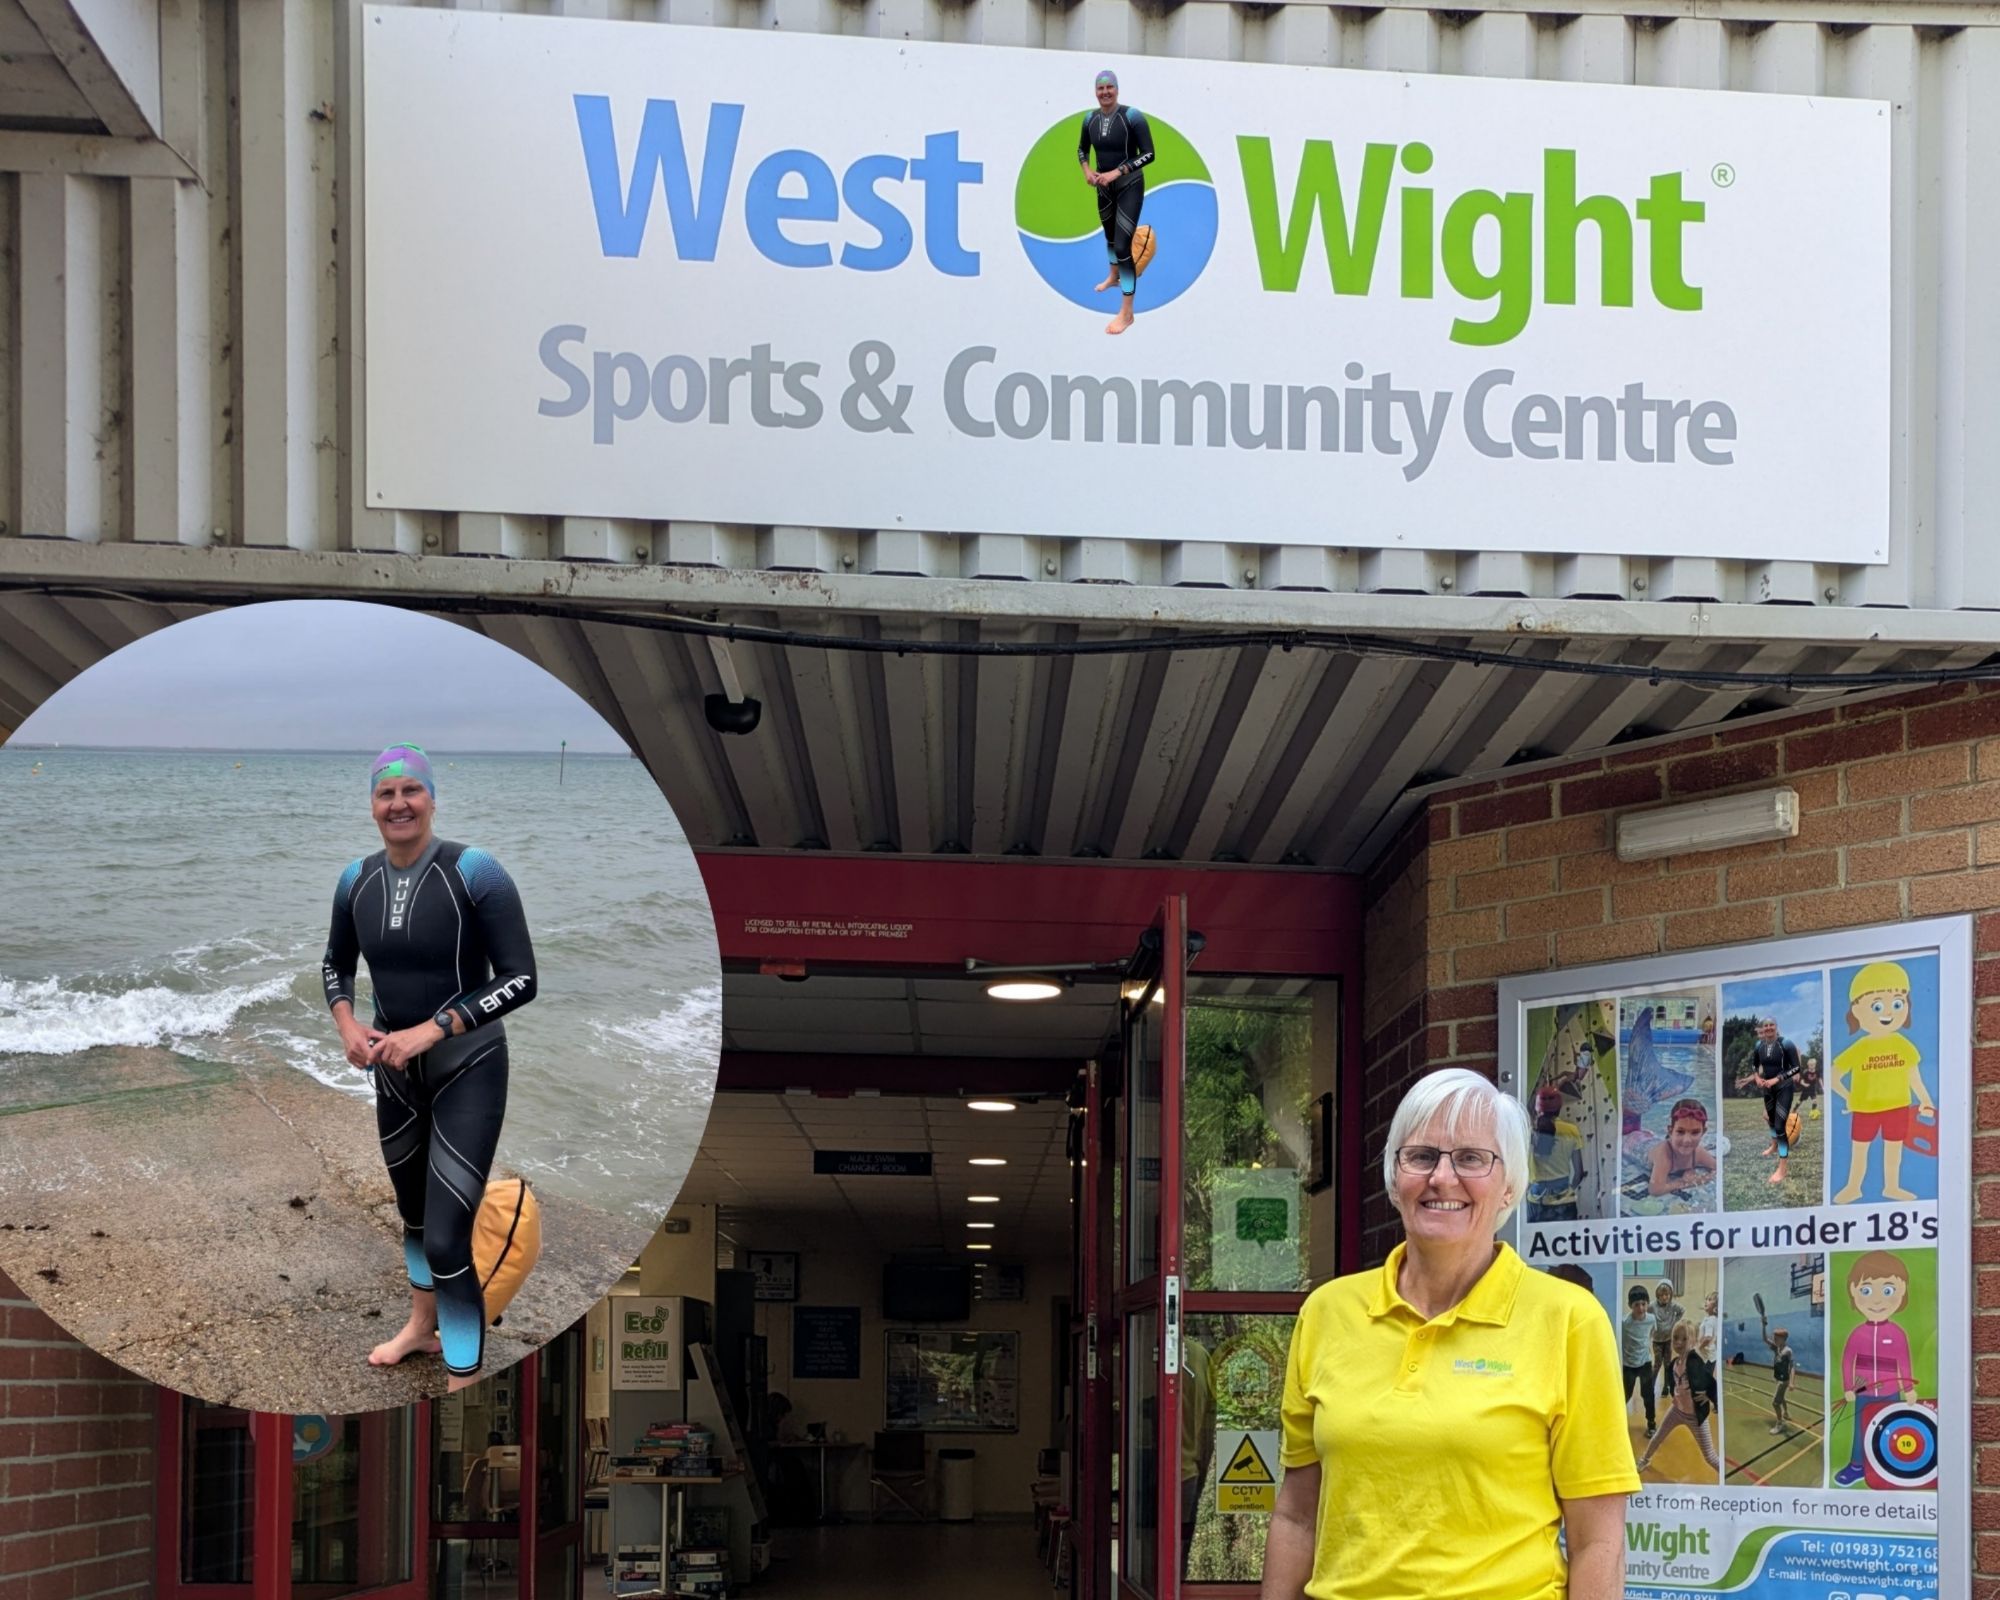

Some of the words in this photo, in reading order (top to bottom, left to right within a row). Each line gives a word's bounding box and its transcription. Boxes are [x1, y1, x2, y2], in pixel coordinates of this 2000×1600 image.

[573, 94, 983, 276] West
[1236, 135, 1705, 346] Wight
[538, 324, 823, 445] Sports
[841, 340, 913, 433] &
[944, 346, 1452, 482] Community
[1464, 369, 1737, 465] Centre
[391, 877, 410, 928] HUUB
[744, 919, 774, 927] LICENSED
[786, 920, 800, 928] SELL
[834, 921, 846, 929] ALL
[865, 930, 876, 938] THE
[1861, 1059, 1905, 1071] LIFEGUARD
[1868, 1053, 1898, 1063] ROOKIE
[1529, 1225, 1681, 1258] Activities
[1690, 1221, 1742, 1251] for
[1752, 1213, 1857, 1246] under
[1867, 1211, 1938, 1243] 18's
[625, 1311, 665, 1334] Eco
[622, 1339, 669, 1360] Refill
[1231, 1485, 1262, 1496] CCTV
[1656, 1495, 1695, 1510] from
[1701, 1496, 1783, 1515] Reception
[1793, 1499, 1818, 1515] for
[1824, 1504, 1870, 1517] more
[1876, 1502, 1937, 1521] details
[1625, 1522, 1710, 1561] Wight
[1801, 1540, 1825, 1553] Tel:
[1830, 1541, 1884, 1558] (01983)
[1663, 1562, 1710, 1580] Centre
[1769, 1568, 1807, 1581] E-mail:
